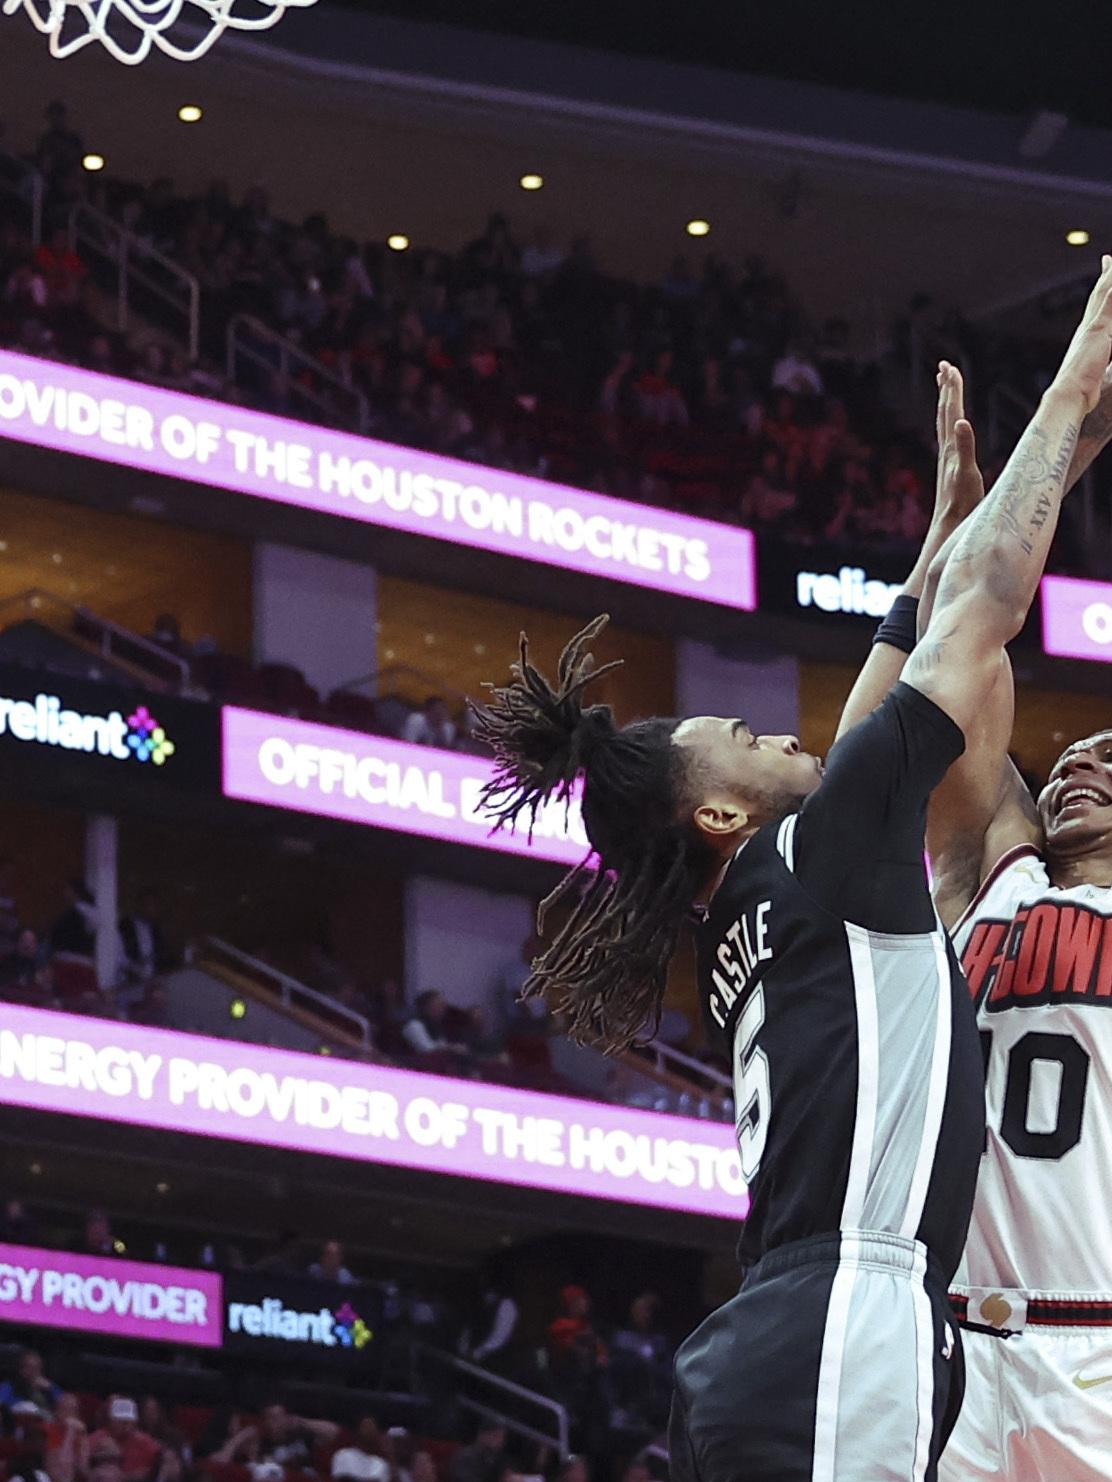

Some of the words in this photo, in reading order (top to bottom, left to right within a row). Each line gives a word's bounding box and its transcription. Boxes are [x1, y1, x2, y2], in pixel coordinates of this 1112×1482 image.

[161, 414, 222, 463] OF
[225, 428, 313, 488] THE
[318, 452, 523, 537] HOUSTON
[528, 501, 711, 581] ROCKETS
[0, 693, 130, 759] reliant
[258, 737, 457, 817] OFFICIAL
[168, 1058, 400, 1139] PROVIDER
[404, 1097, 468, 1149] OF
[473, 1108, 567, 1167] THE
[732, 980, 773, 1185] 5
[42, 1269, 208, 1326] PROVIDER
[228, 1297, 338, 1347] reliant
